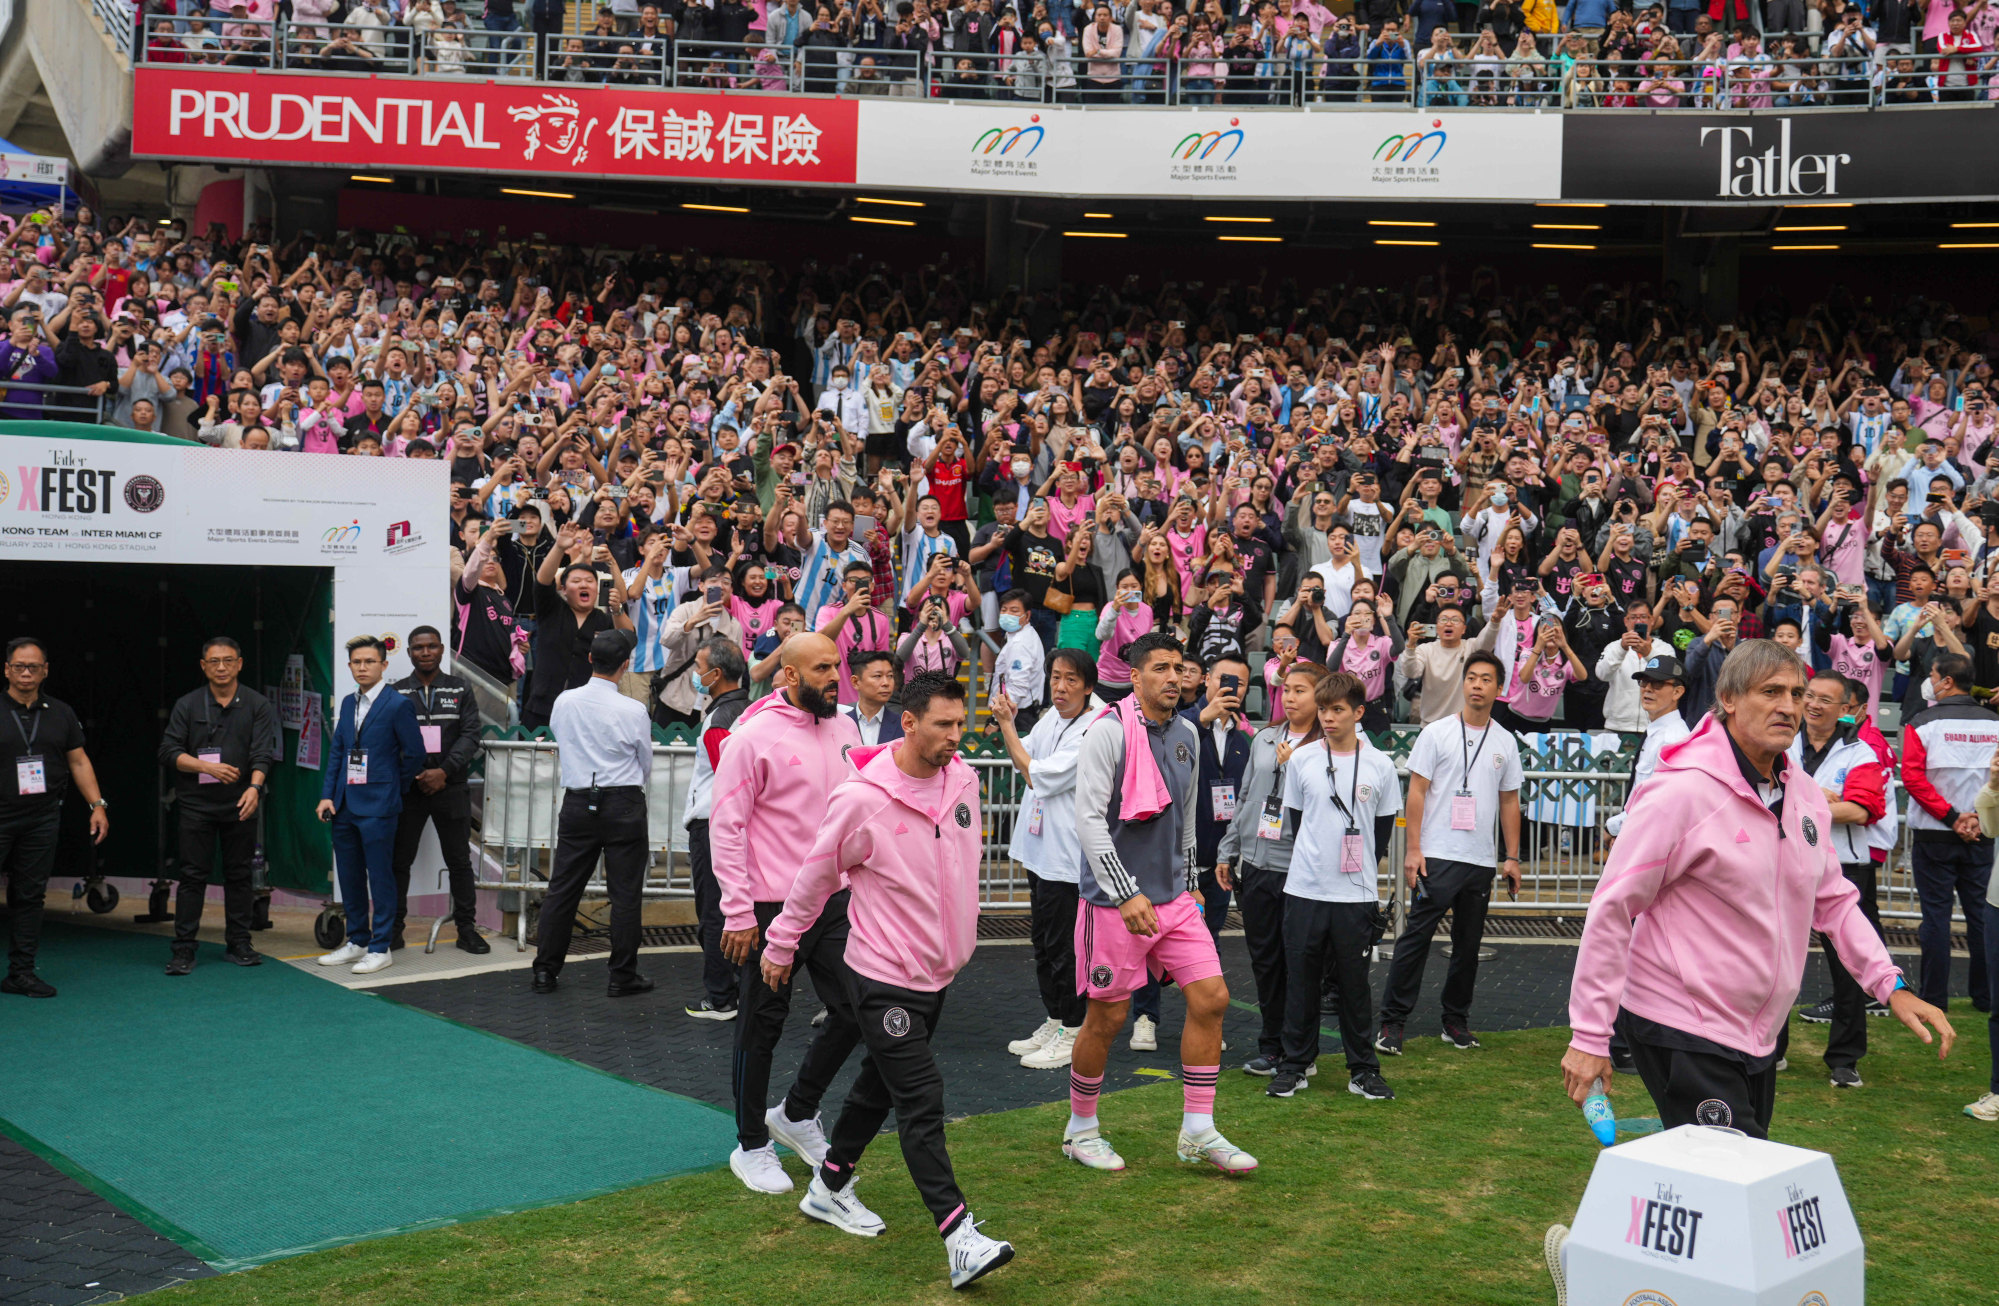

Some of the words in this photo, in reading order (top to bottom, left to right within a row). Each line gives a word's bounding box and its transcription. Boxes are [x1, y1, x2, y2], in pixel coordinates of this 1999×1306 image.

[169, 88, 500, 149] PRUDENTIAL
[607, 106, 822, 165] 保誠保險
[971, 159, 1037, 169] 大型體育活動
[1701, 118, 1850, 197] Tatler
[971, 168, 990, 176] Major
[992, 169, 1014, 177] Sports
[1171, 165, 1237, 173] 大型體育活動
[1372, 167, 1439, 175] 大型體育活動
[1171, 173, 1190, 181] Major
[1372, 175, 1391, 183] Major
[49, 449, 87, 466] Tatler
[17, 466, 116, 514] XFEST
[2, 527, 35, 536] KONG
[37, 528, 69, 537] TEAM
[81, 529, 113, 538] INTER
[115, 530, 147, 539] MIAMI
[148, 531, 162, 539] CF
[32, 541, 53, 549] 2024
[1944, 733, 1967, 742] GUARD
[1655, 1181, 1682, 1204] Tatler
[1625, 1195, 1703, 1260] XFEST
[1776, 1196, 1826, 1259] XFEST
[1641, 1249, 1660, 1259] HONG
[1661, 1253, 1680, 1264] KONG
